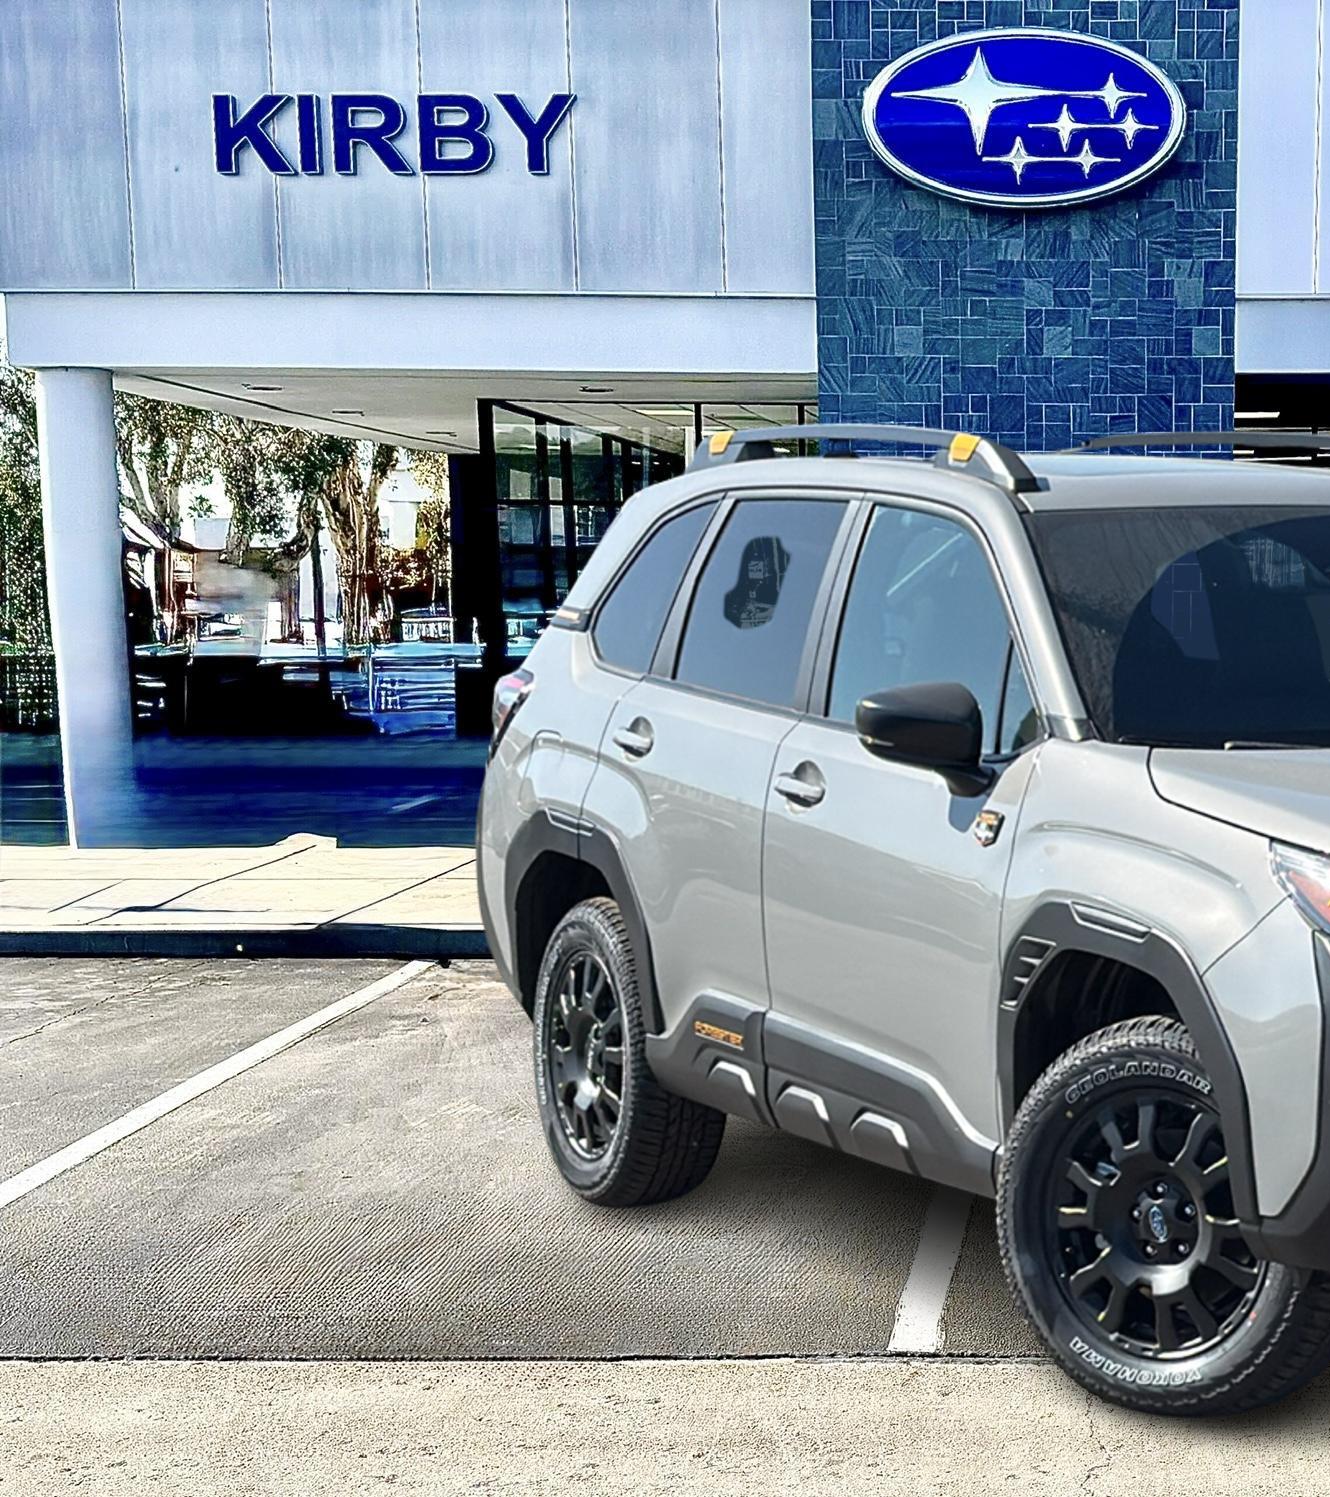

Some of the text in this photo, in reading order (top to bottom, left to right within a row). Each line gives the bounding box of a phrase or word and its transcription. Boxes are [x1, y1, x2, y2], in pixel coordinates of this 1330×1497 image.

[211, 92, 577, 176] KIRBY
[1065, 1061, 1212, 1104] GEOLANDAR
[1069, 1336, 1202, 1386] YOKOHAMA
